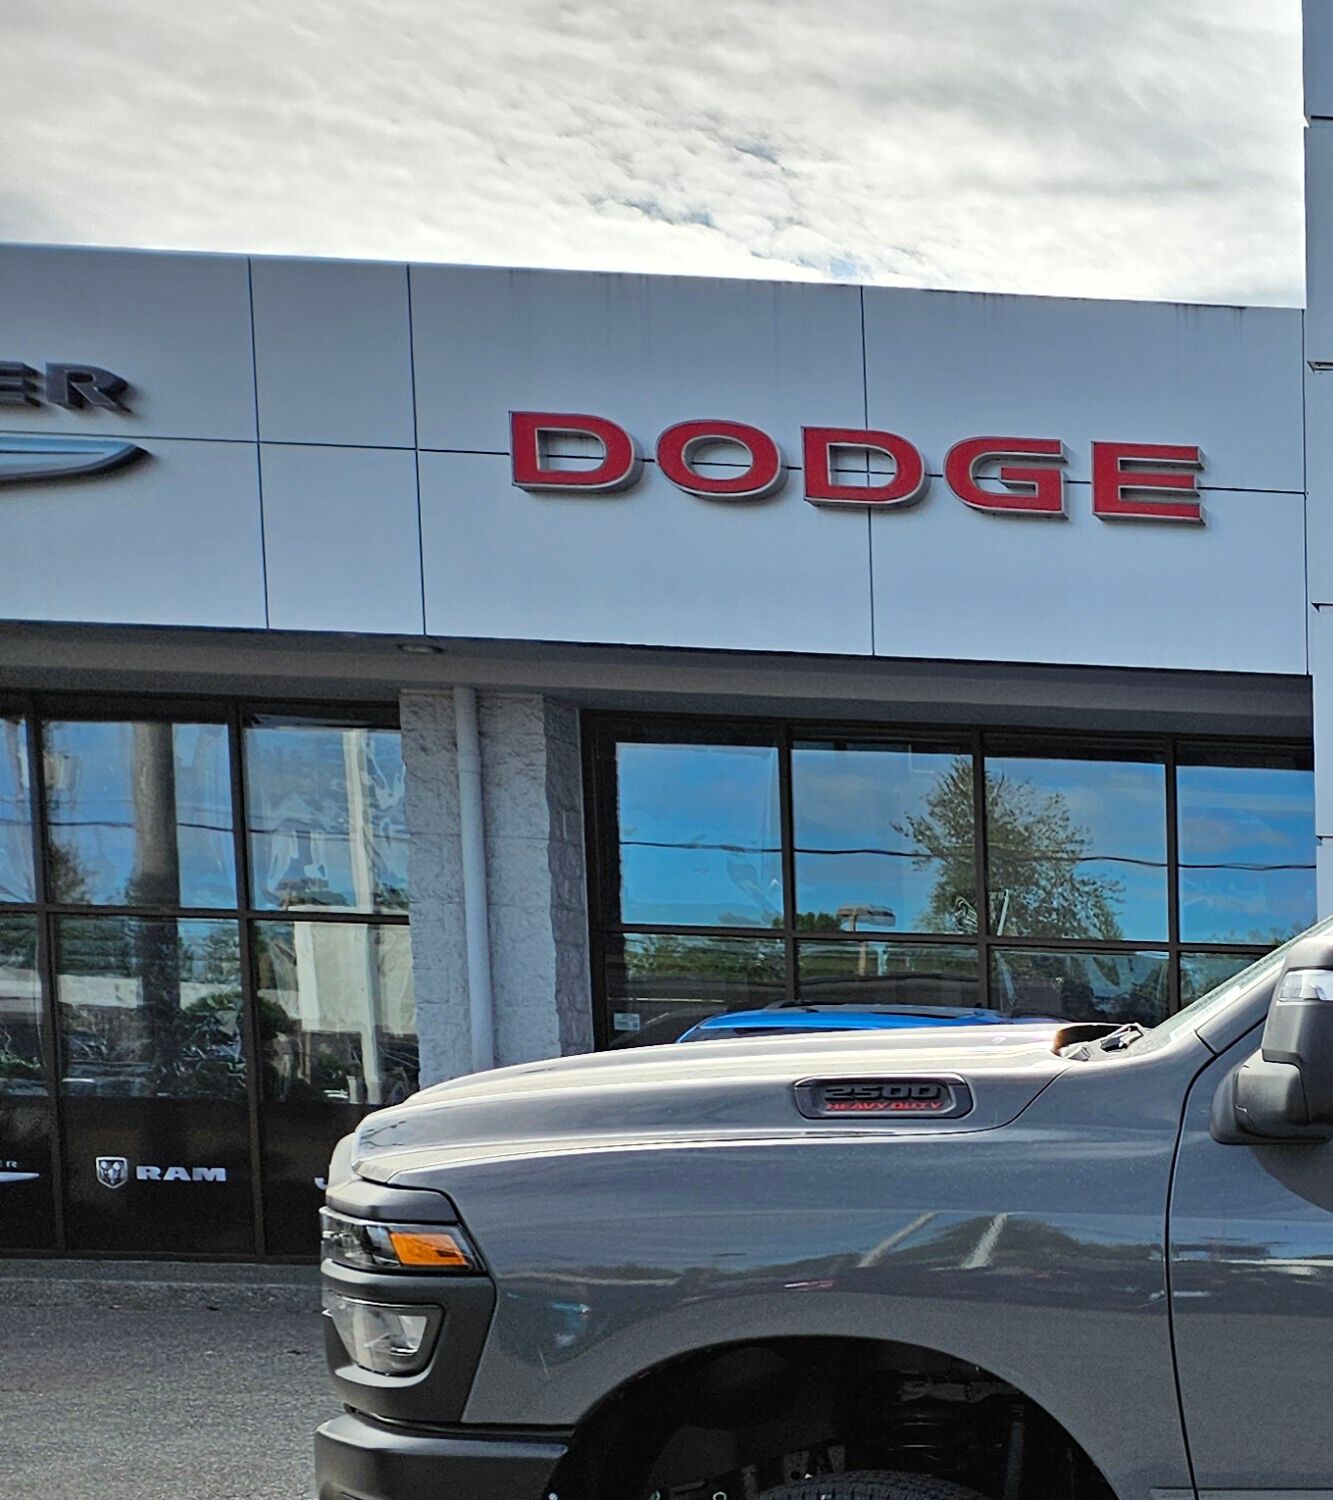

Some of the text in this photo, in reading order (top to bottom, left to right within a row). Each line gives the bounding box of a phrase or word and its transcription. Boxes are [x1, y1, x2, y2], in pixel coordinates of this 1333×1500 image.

[508, 410, 1206, 525] DODGE
[824, 1086, 941, 1101] 2500
[826, 1102, 944, 1111] HEAVY DUTY
[136, 1165, 227, 1182] RAM
